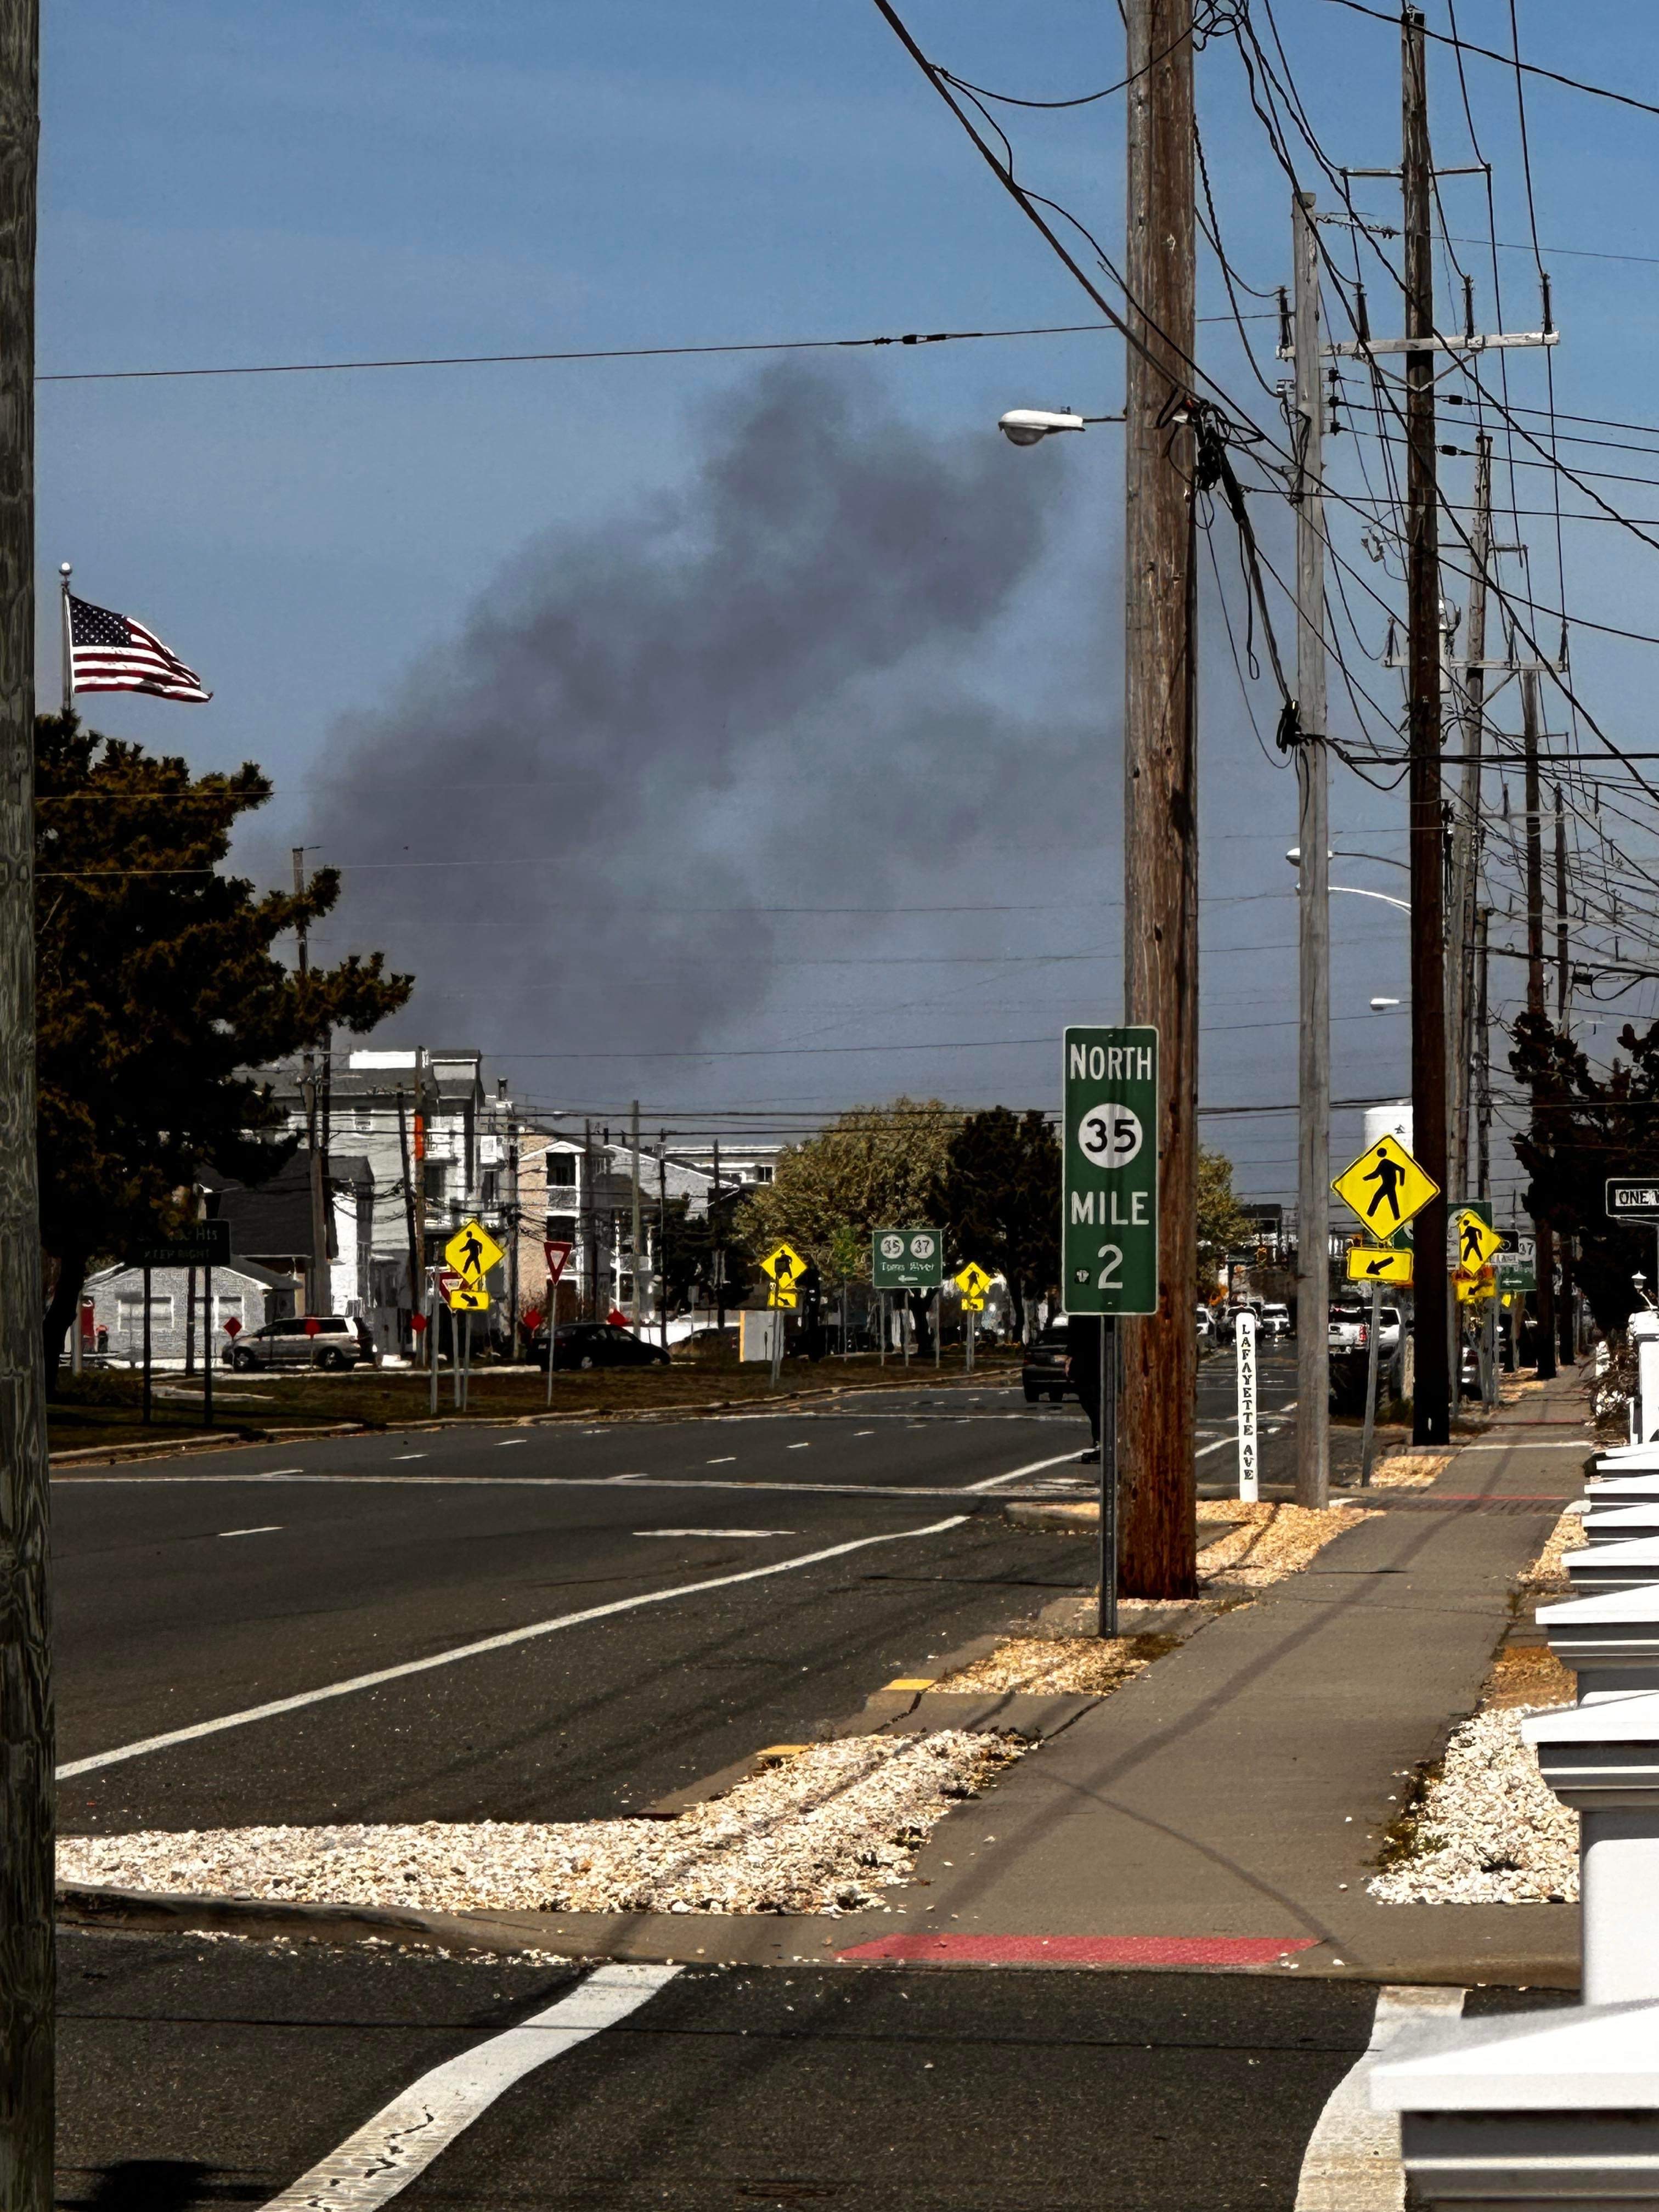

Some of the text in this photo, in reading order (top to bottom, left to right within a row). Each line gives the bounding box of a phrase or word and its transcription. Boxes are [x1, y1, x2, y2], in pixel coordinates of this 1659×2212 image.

[1070, 1043, 1152, 1080] NORTH
[1085, 1118, 1136, 1153] 35
[1071, 1191, 1149, 1225] MILE
[1619, 1190, 1649, 1204] ONE
[884, 1239, 930, 1254] 35 37
[1098, 1244, 1123, 1289] 2
[1241, 1324, 1254, 1481] LAFAYETTE AVE
